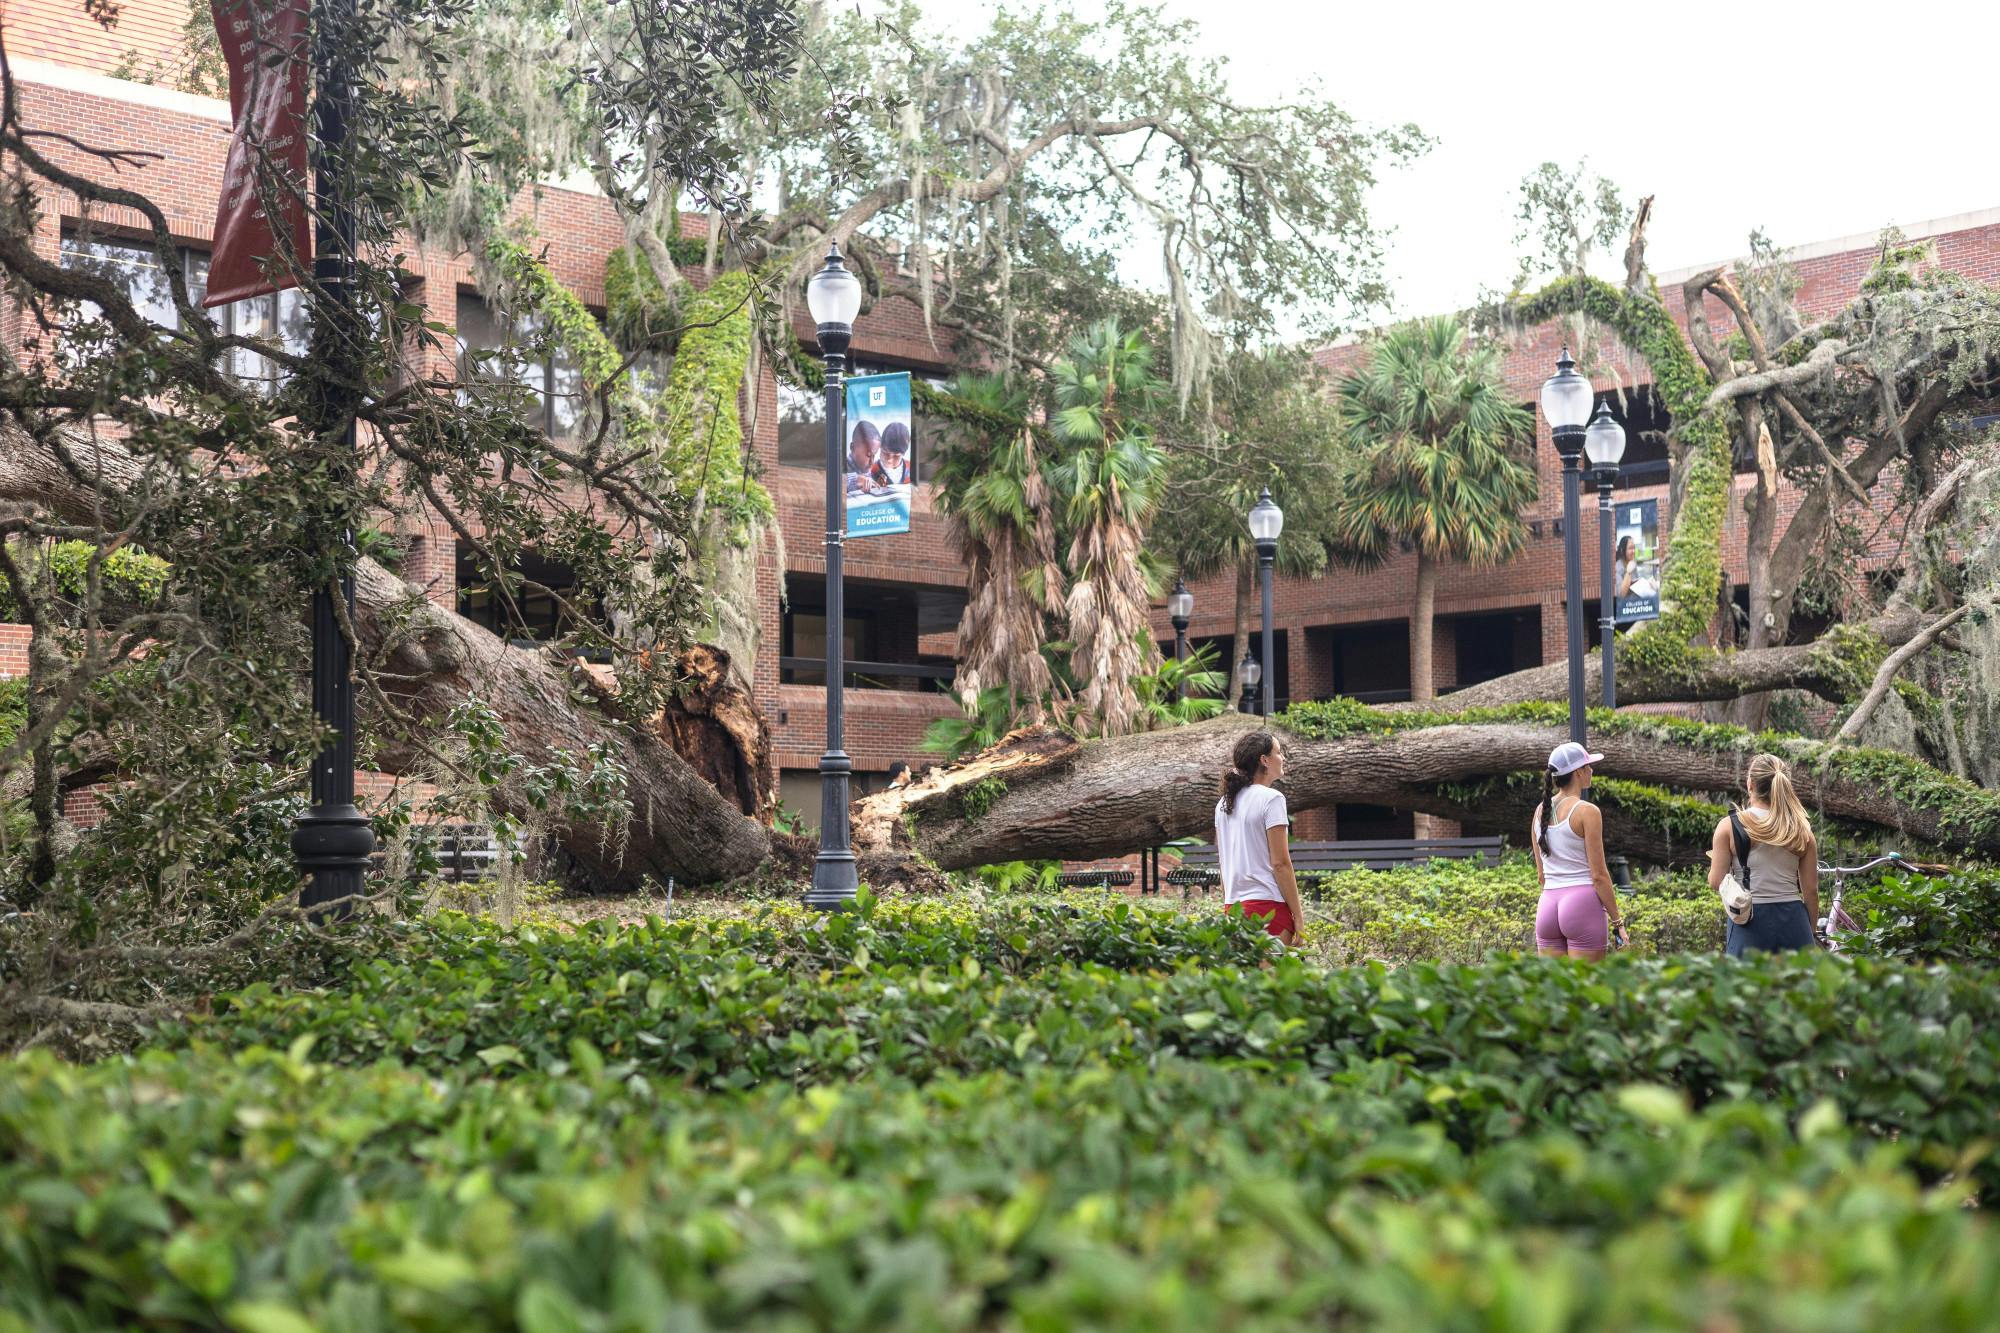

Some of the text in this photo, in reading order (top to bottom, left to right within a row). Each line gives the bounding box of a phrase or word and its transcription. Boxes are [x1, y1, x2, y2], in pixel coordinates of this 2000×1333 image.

[873, 392, 882, 401] UF
[861, 507, 895, 517] COLLEGE OF
[856, 514, 901, 526] EDUCATION
[1622, 605, 1653, 614] EDUCATION
